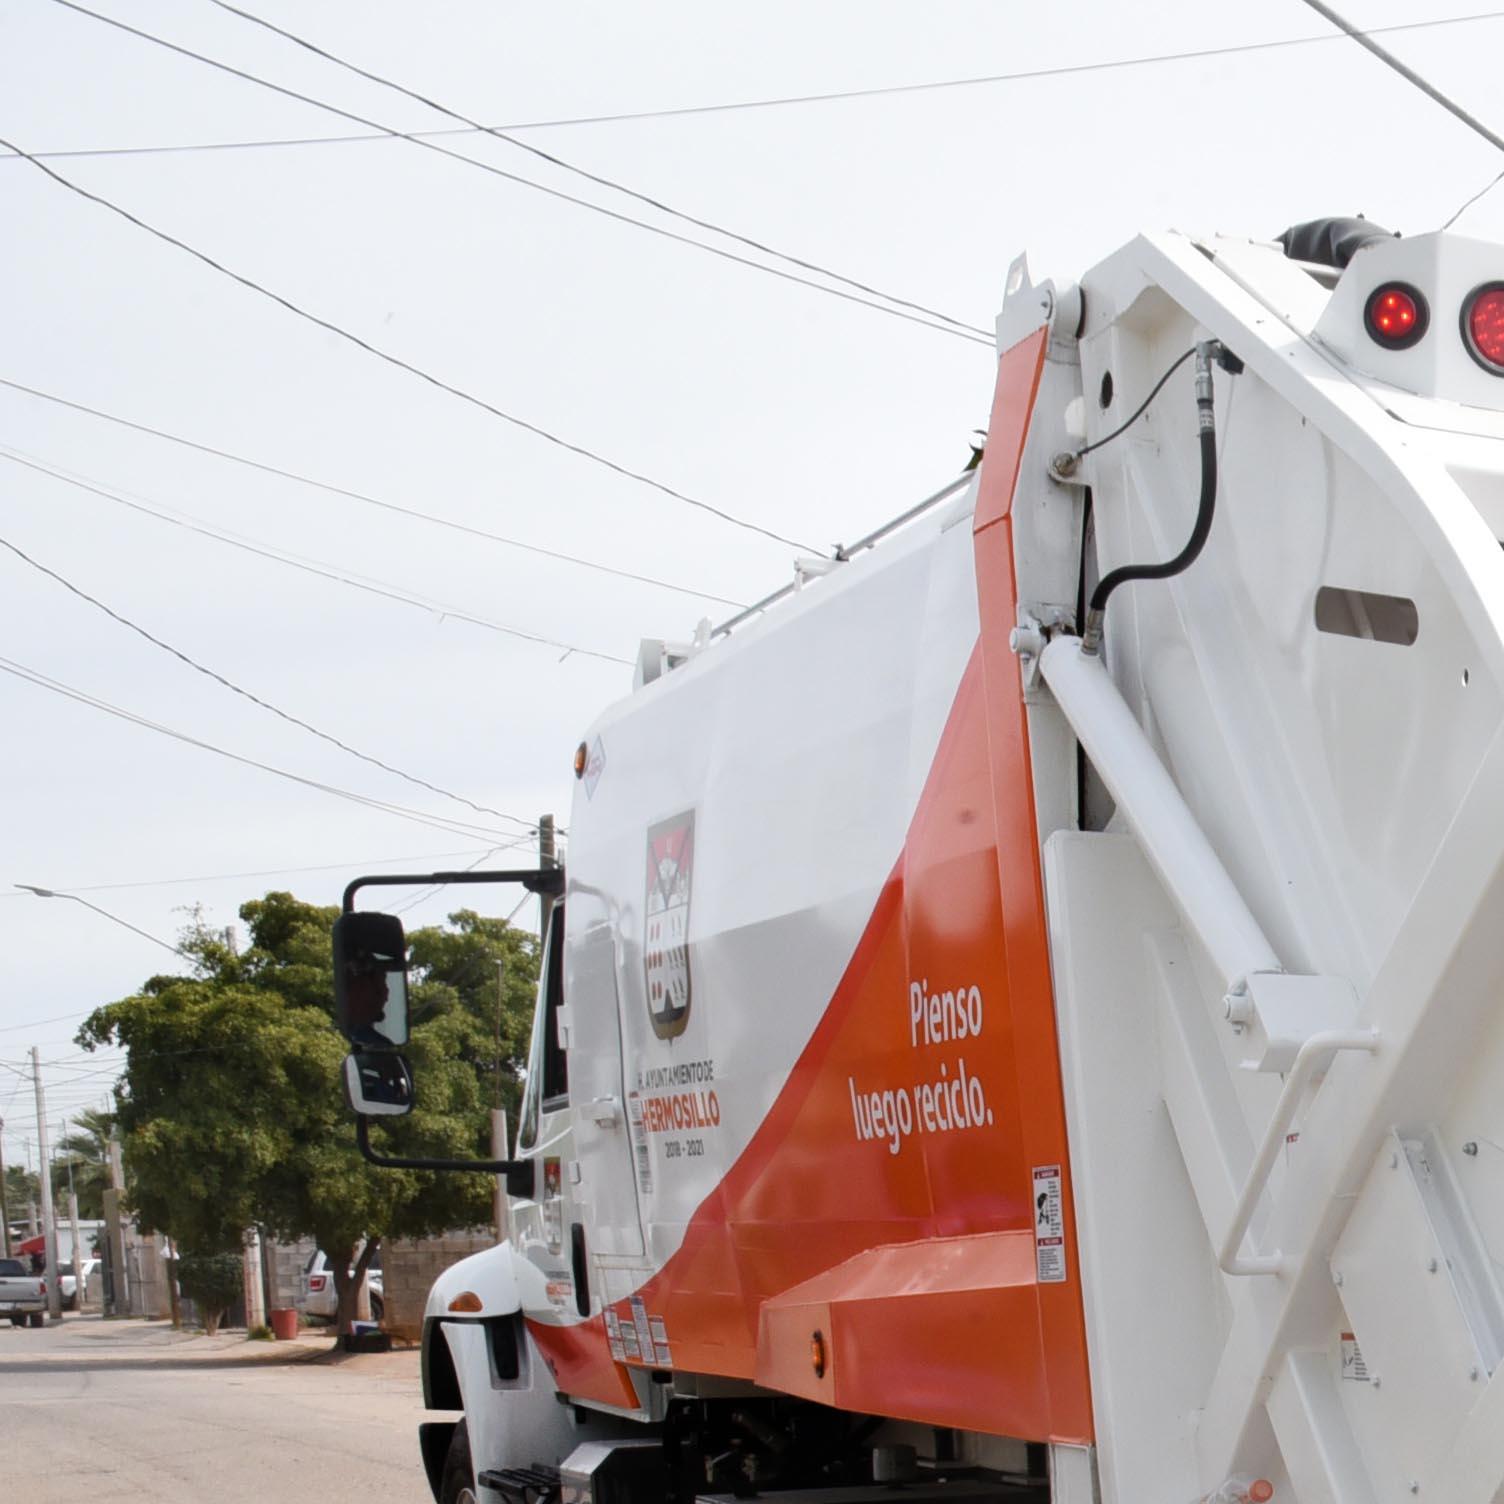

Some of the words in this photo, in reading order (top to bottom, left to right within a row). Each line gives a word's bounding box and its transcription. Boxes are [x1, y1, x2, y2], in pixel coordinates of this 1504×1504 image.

[910, 978, 982, 1047] Pienso
[645, 1062, 703, 1089] AYUNTAMIENTO
[703, 1060, 714, 1082] DE
[641, 1090, 721, 1133] HERMOSILLO
[849, 1076, 913, 1155] luego
[913, 1058, 993, 1134] reciclo.
